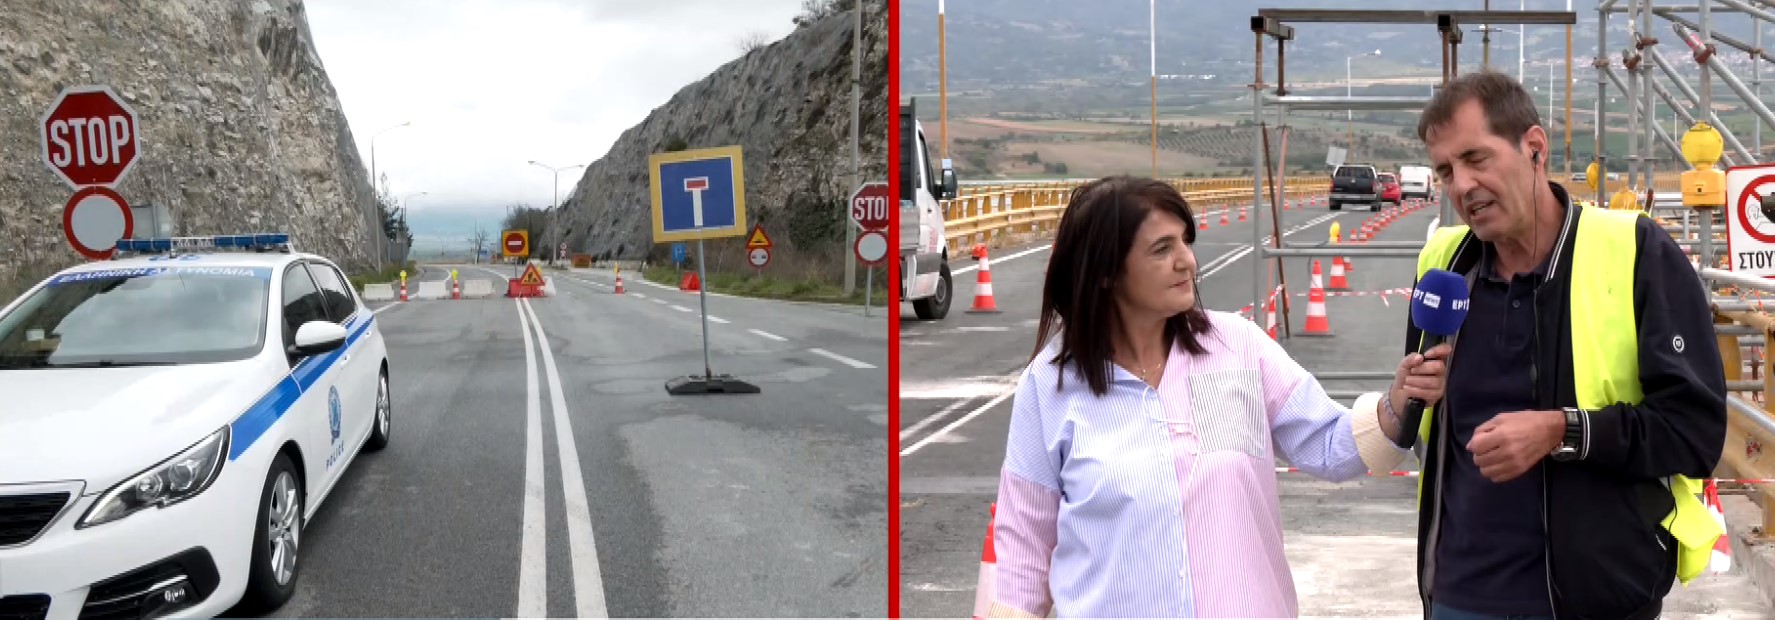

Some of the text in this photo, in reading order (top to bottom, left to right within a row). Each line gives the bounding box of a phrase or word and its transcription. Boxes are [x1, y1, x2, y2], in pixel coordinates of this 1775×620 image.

[50, 115, 130, 168] STOP
[854, 196, 888, 220] STO
[1739, 250, 1775, 270] ΣΤΟΥ
[58, 268, 146, 283] ΕΛΛΗΝΙΚΗ
[326, 440, 345, 472] POLICE
